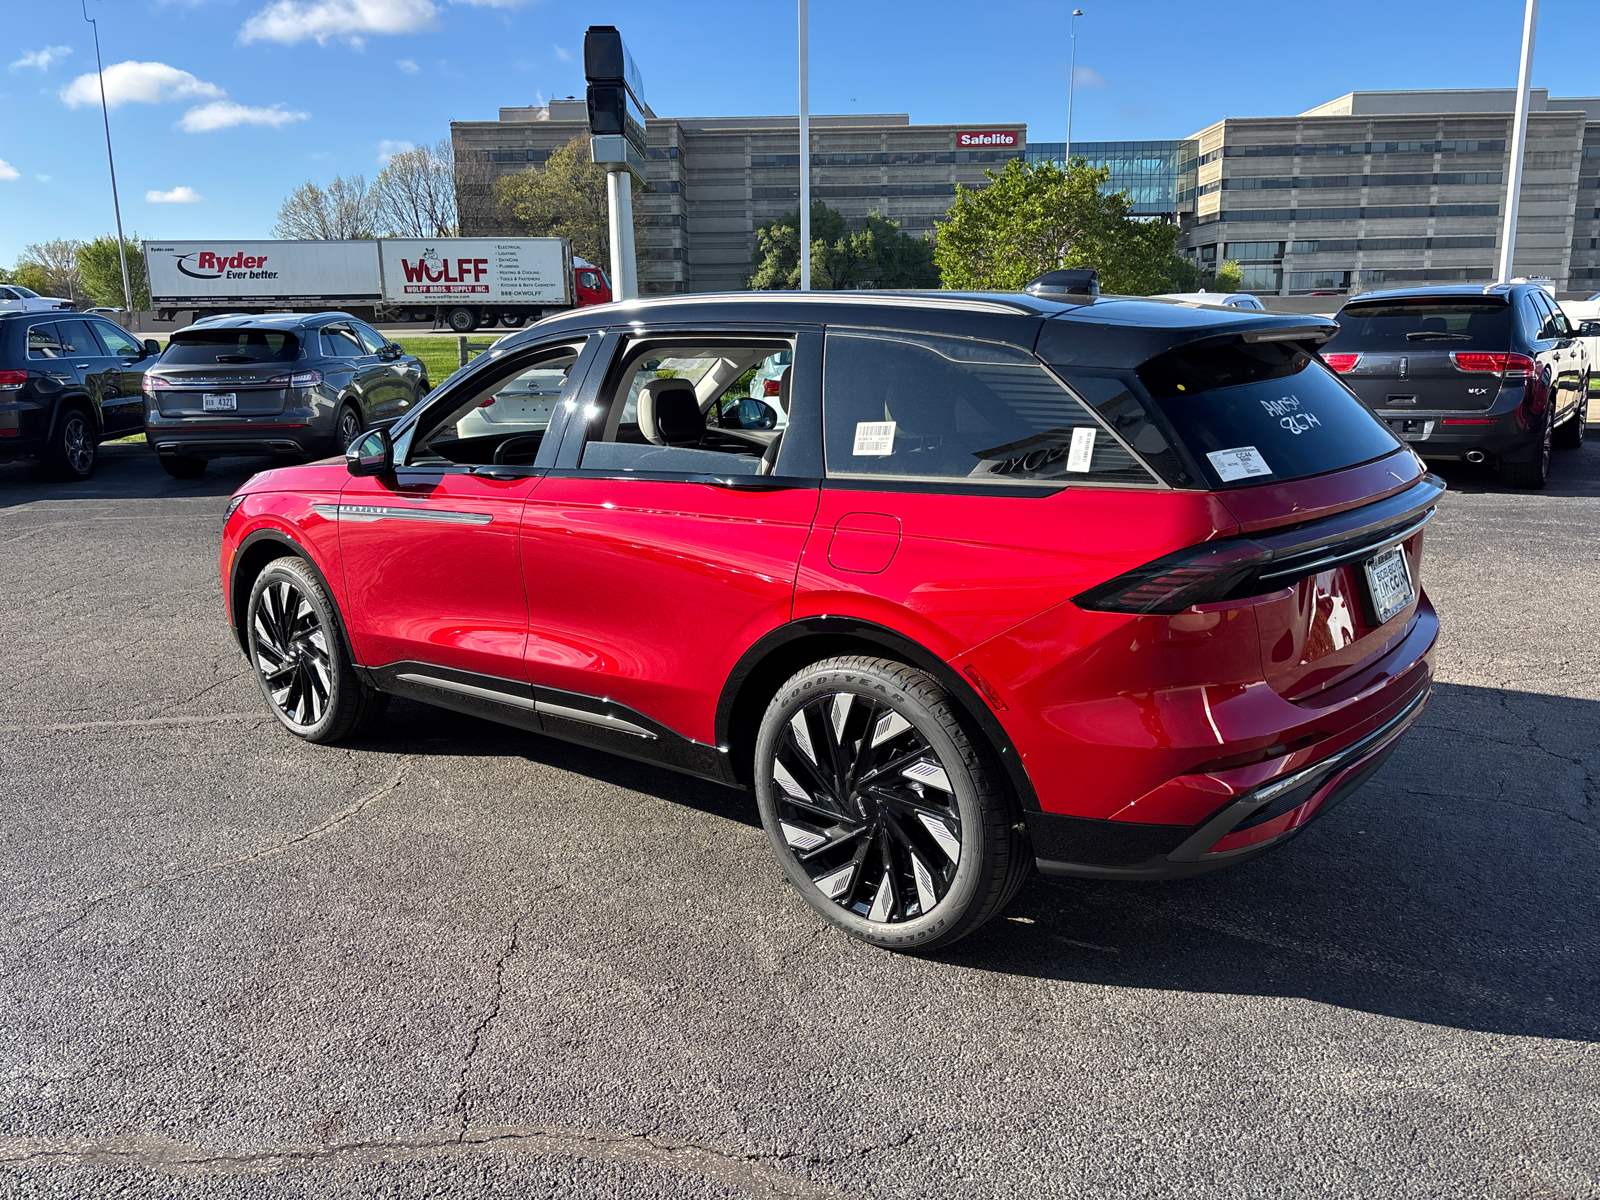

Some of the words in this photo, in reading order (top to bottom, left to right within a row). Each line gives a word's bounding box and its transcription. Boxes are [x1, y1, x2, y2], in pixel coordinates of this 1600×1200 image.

[960, 133, 1014, 145] Safelite
[198, 252, 268, 273] Ryder
[226, 270, 248, 280] Ever
[249, 270, 279, 280] better.
[401, 258, 488, 283] WOLFF
[218, 398, 233, 407] 4321
[340, 505, 388, 514] NAUTILUS
[895, 918, 946, 943] EAGLE
